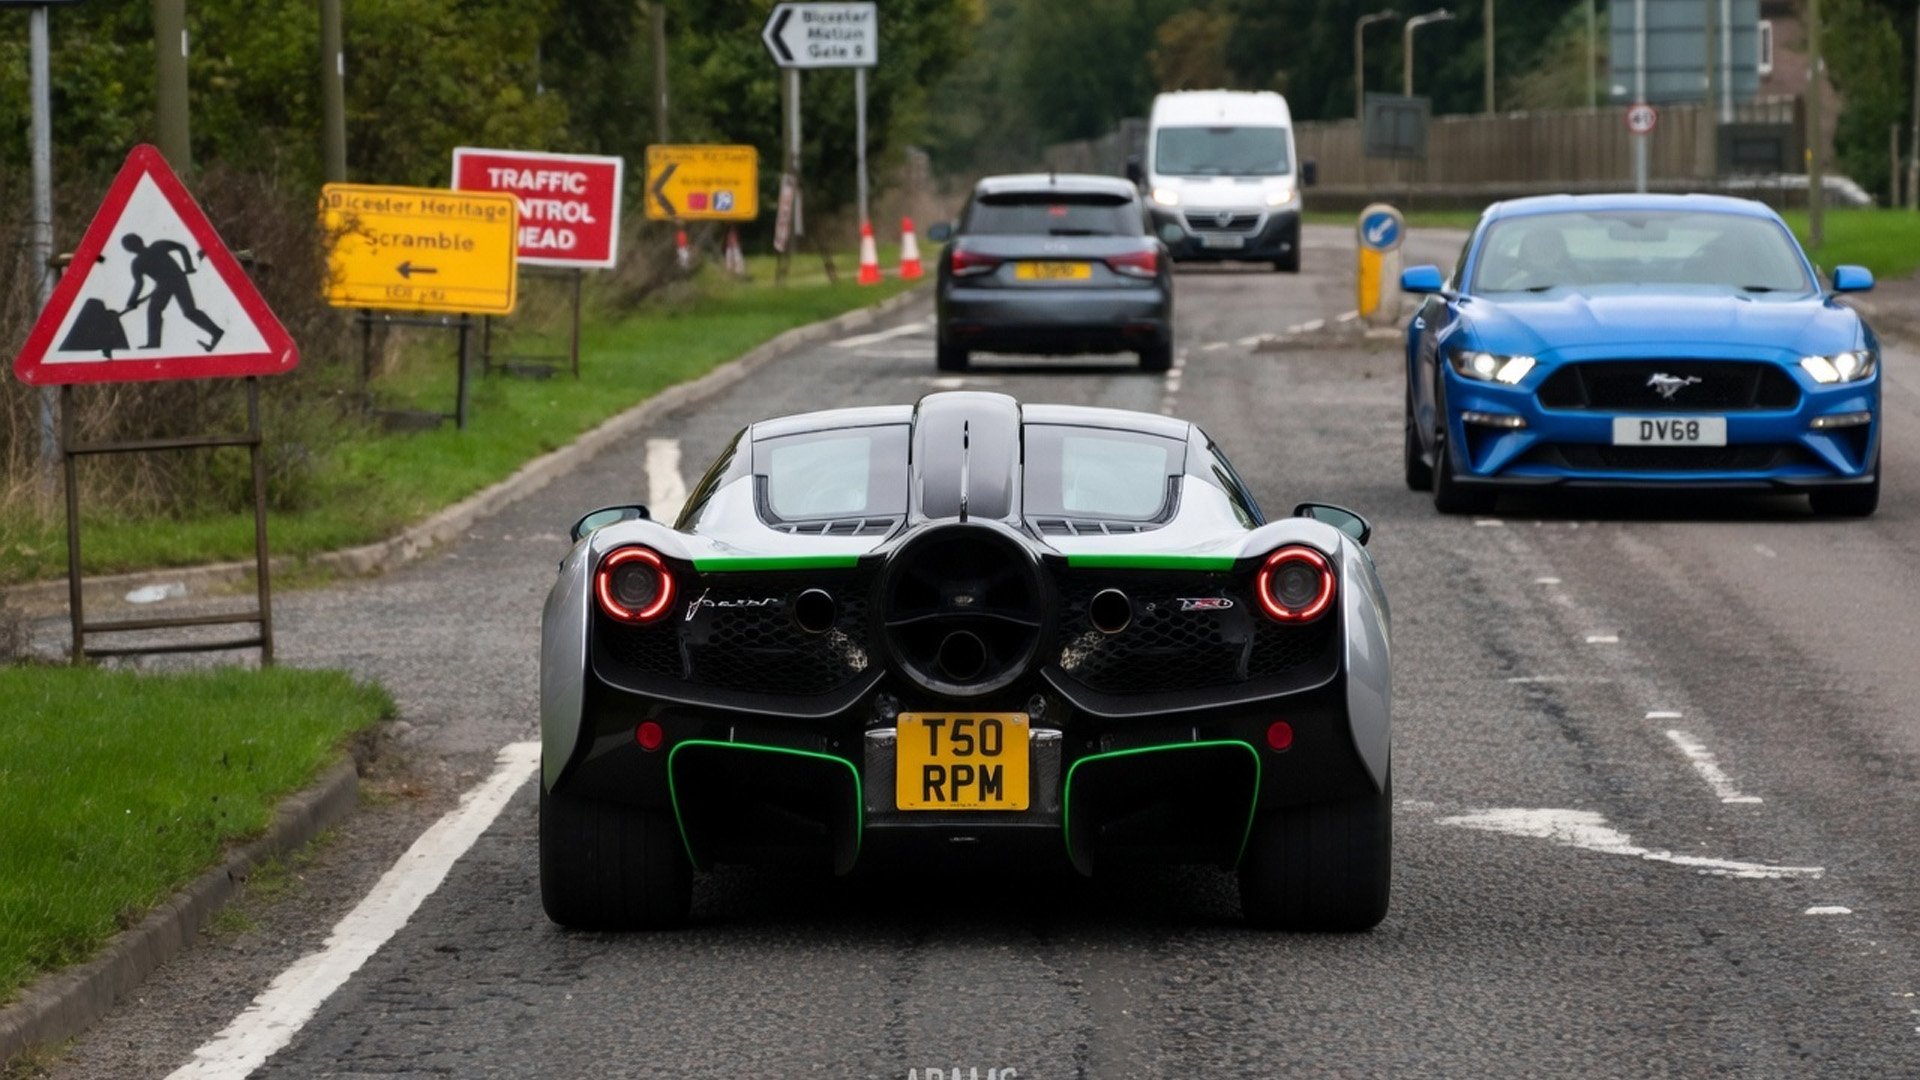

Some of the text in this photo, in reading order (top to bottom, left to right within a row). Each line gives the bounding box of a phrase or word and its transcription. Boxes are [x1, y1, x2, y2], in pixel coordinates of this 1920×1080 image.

[488, 168, 588, 194] TRAFFIC
[420, 199, 507, 222] Heritage
[366, 229, 475, 251] Scramble
[1640, 420, 1700, 441] DV68
[922, 718, 1003, 757] T50
[922, 764, 1003, 802] RPM
